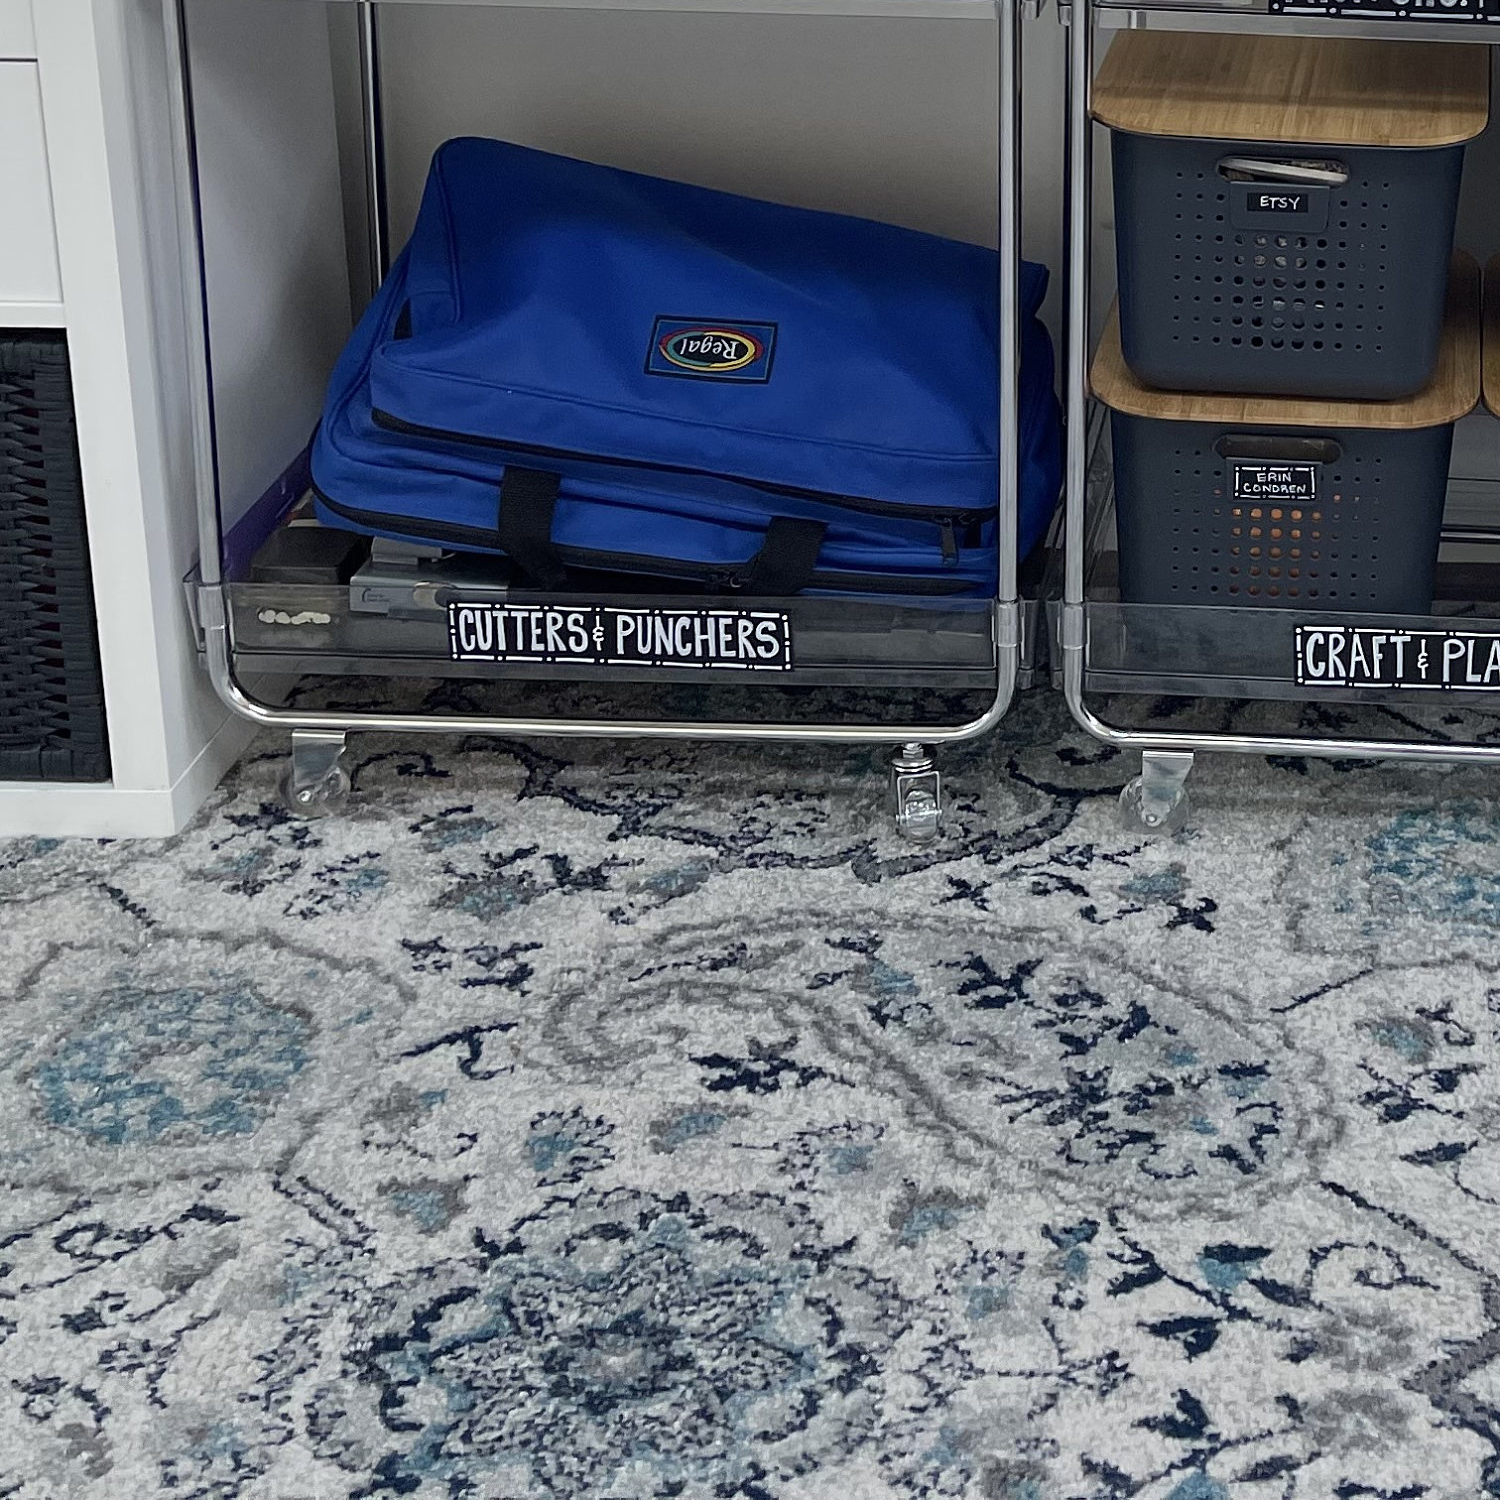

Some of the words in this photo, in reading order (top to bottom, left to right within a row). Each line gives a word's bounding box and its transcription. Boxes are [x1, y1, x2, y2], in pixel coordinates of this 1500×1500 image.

[1260, 195, 1301, 210] ETSY
[680, 335, 740, 360] Regal
[1256, 472, 1292, 482] ERIN
[1243, 482, 1307, 494] CONDREN
[459, 608, 589, 653] CUTTERS
[592, 615, 604, 651] &
[617, 615, 780, 659] PUNCHERS
[1306, 632, 1411, 679] CRAFT
[1417, 639, 1429, 680] &
